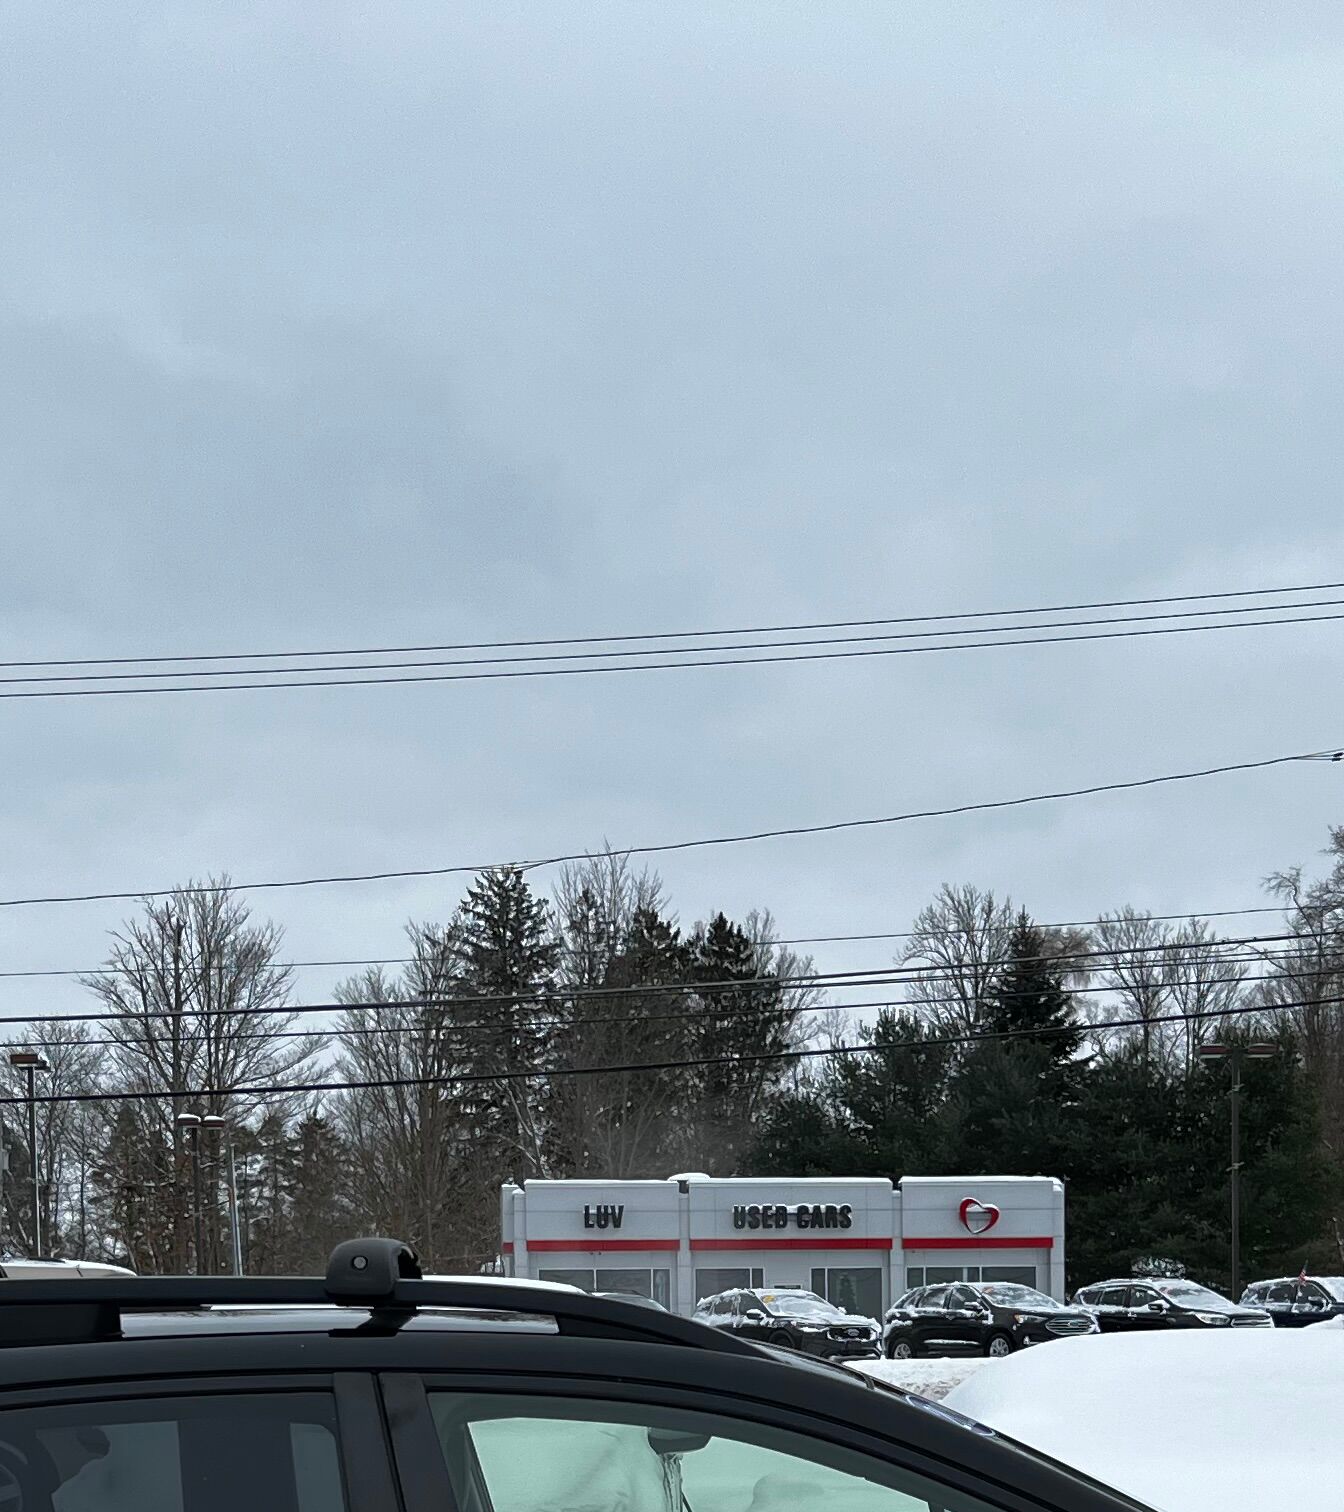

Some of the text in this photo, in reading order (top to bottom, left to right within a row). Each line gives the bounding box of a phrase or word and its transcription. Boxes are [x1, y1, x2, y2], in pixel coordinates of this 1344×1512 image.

[584, 1204, 624, 1229] LUV
[733, 1205, 852, 1229] USED CARS
